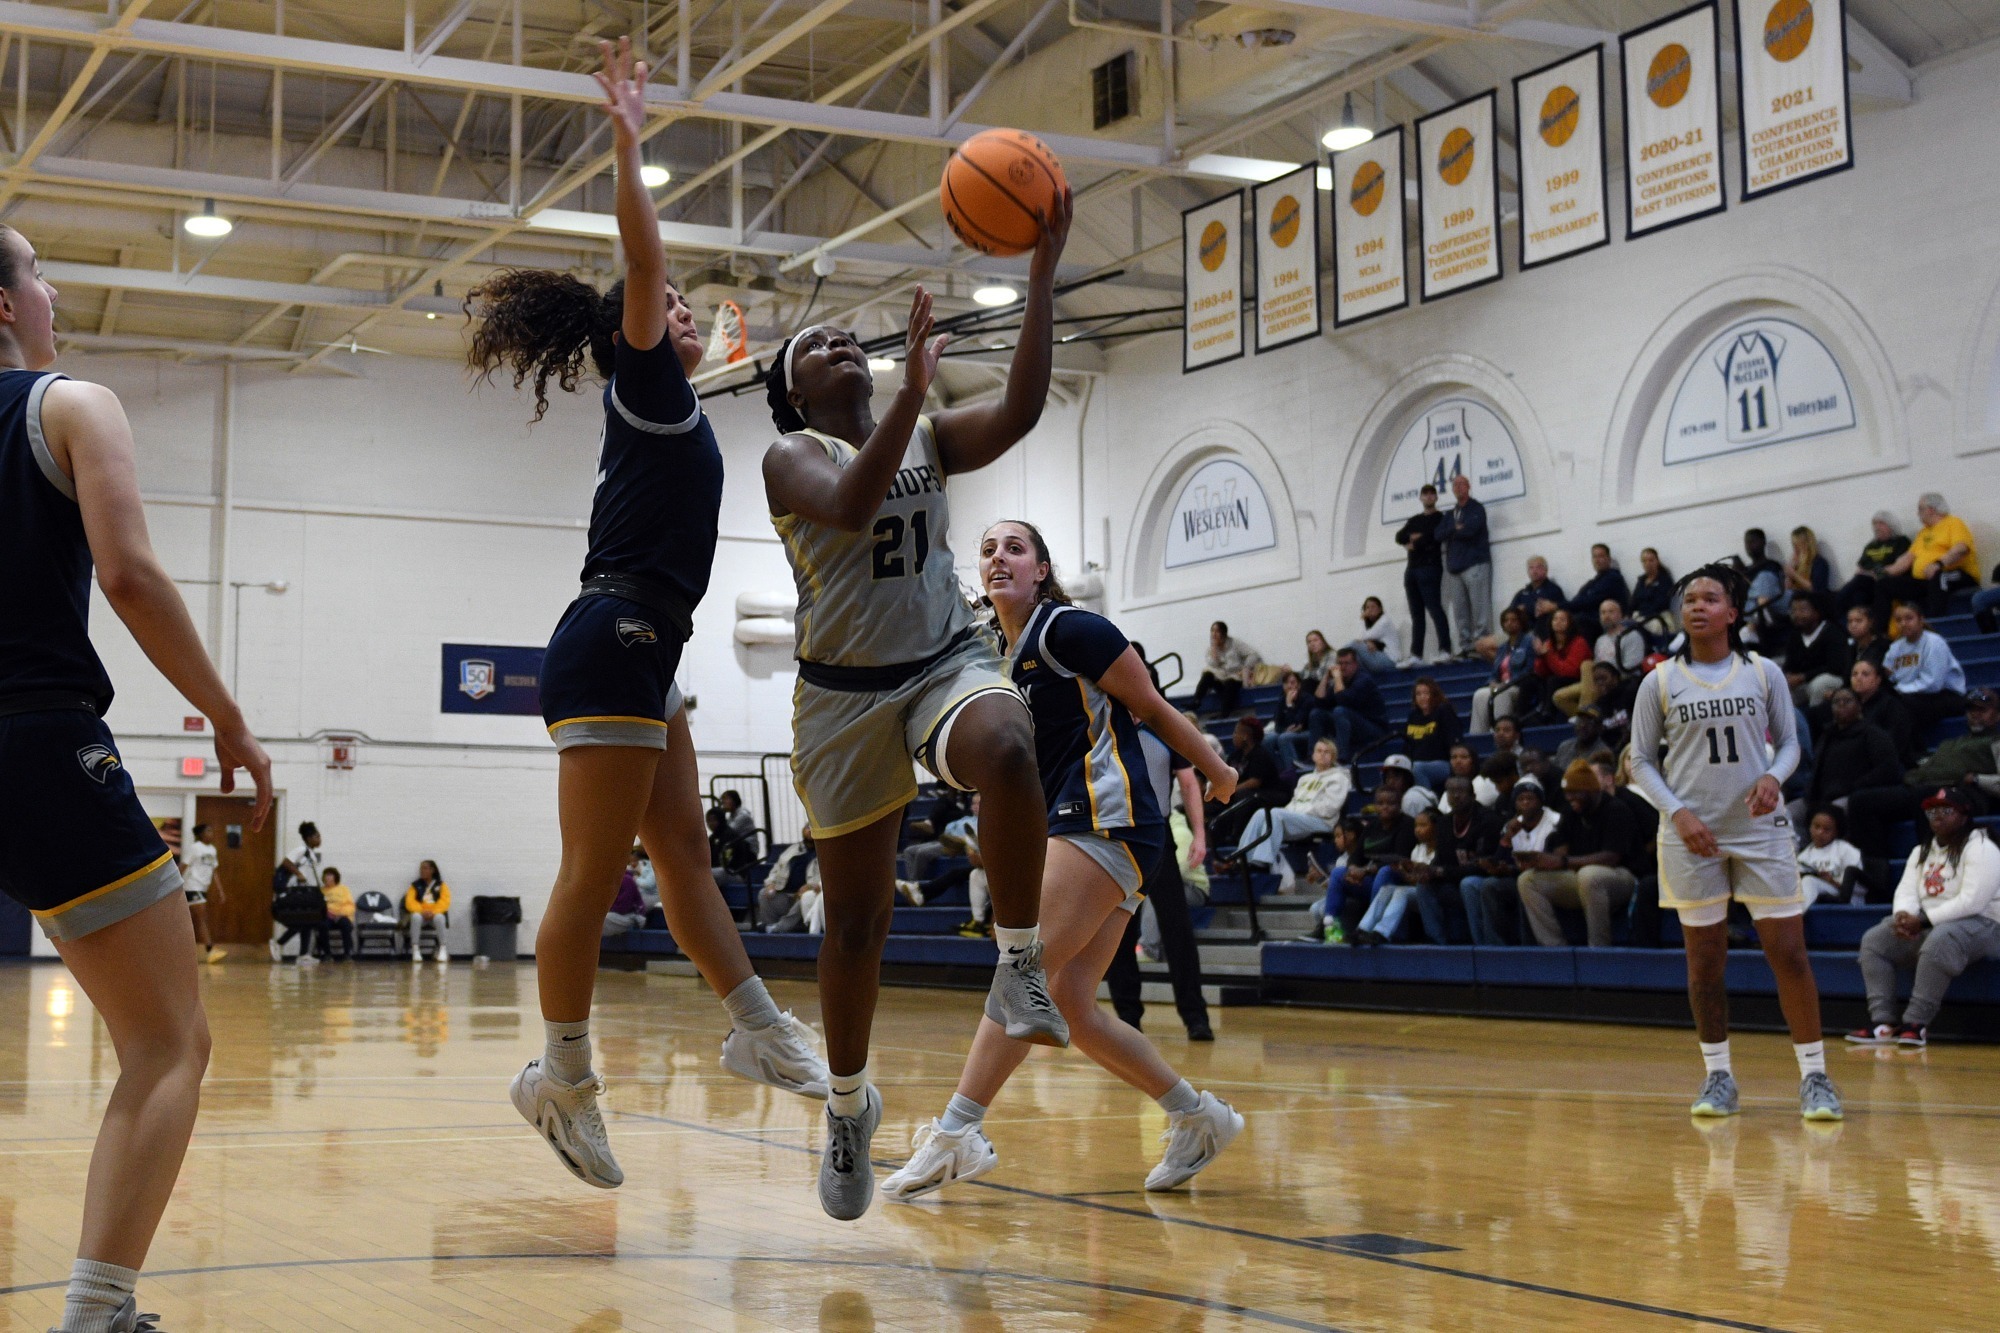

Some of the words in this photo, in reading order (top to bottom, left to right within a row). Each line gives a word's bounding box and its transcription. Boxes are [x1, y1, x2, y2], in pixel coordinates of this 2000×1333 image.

[1771, 85, 1814, 114] 2021
[1752, 107, 1838, 144] CONFERENCE
[1752, 120, 1839, 158] TOURNAMENT
[1640, 128, 1703, 163] 2020-21
[1758, 138, 1833, 171] CHAMPIONS
[1546, 169, 1579, 193] 1999
[1636, 152, 1713, 186] CONFERENCE
[1751, 169, 1781, 187] EAST
[1785, 149, 1843, 176] DIVISION
[1634, 200, 1662, 218] EAST
[1665, 183, 1717, 207] DIVISION
[1640, 170, 1709, 200] CHAMPIONS
[1428, 227, 1490, 255] CONFERENCE
[1529, 212, 1599, 243] TOURNAMENT
[1428, 240, 1491, 268] TOURNAMENT
[1433, 255, 1488, 281] CHAMPIONS
[1342, 277, 1401, 303] TOURNAMENT
[1737, 385, 1768, 433] 11
[872, 510, 929, 579] 21
[1678, 697, 1756, 724] BISHOPS
[1705, 725, 1740, 764] 11
